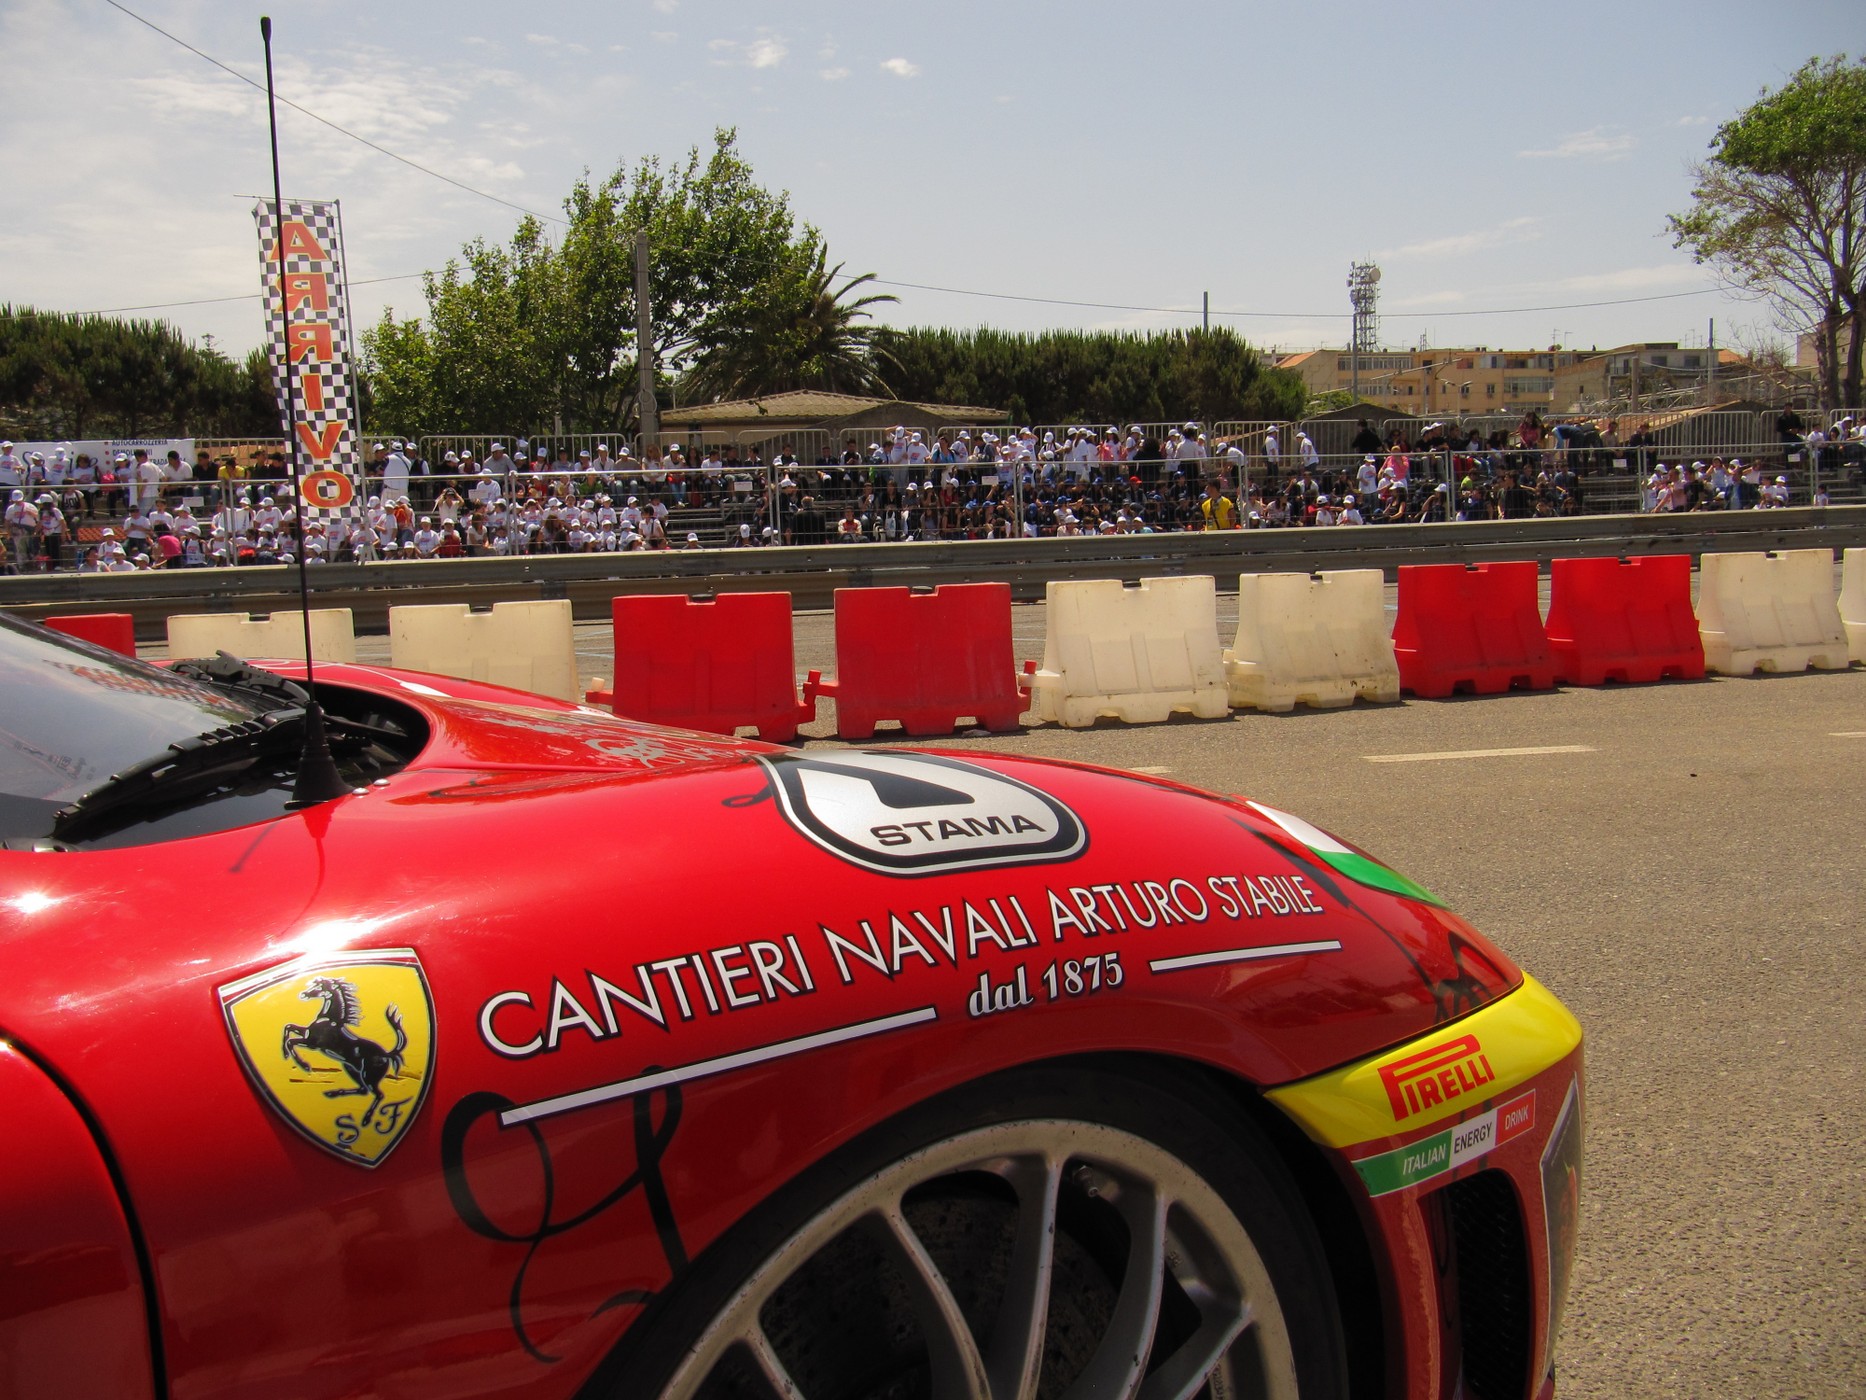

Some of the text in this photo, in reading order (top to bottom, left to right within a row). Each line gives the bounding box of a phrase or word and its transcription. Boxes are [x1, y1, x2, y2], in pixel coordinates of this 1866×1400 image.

[869, 814, 1047, 847] STAMA
[478, 873, 1324, 1058] CANTIERI NAVALI ARTURO STABILE
[968, 951, 1125, 1018] dal 1875
[1377, 1033, 1496, 1122] PIRELLI
[1402, 1104, 1530, 1176] ITALIAN ENERGY DRINK
